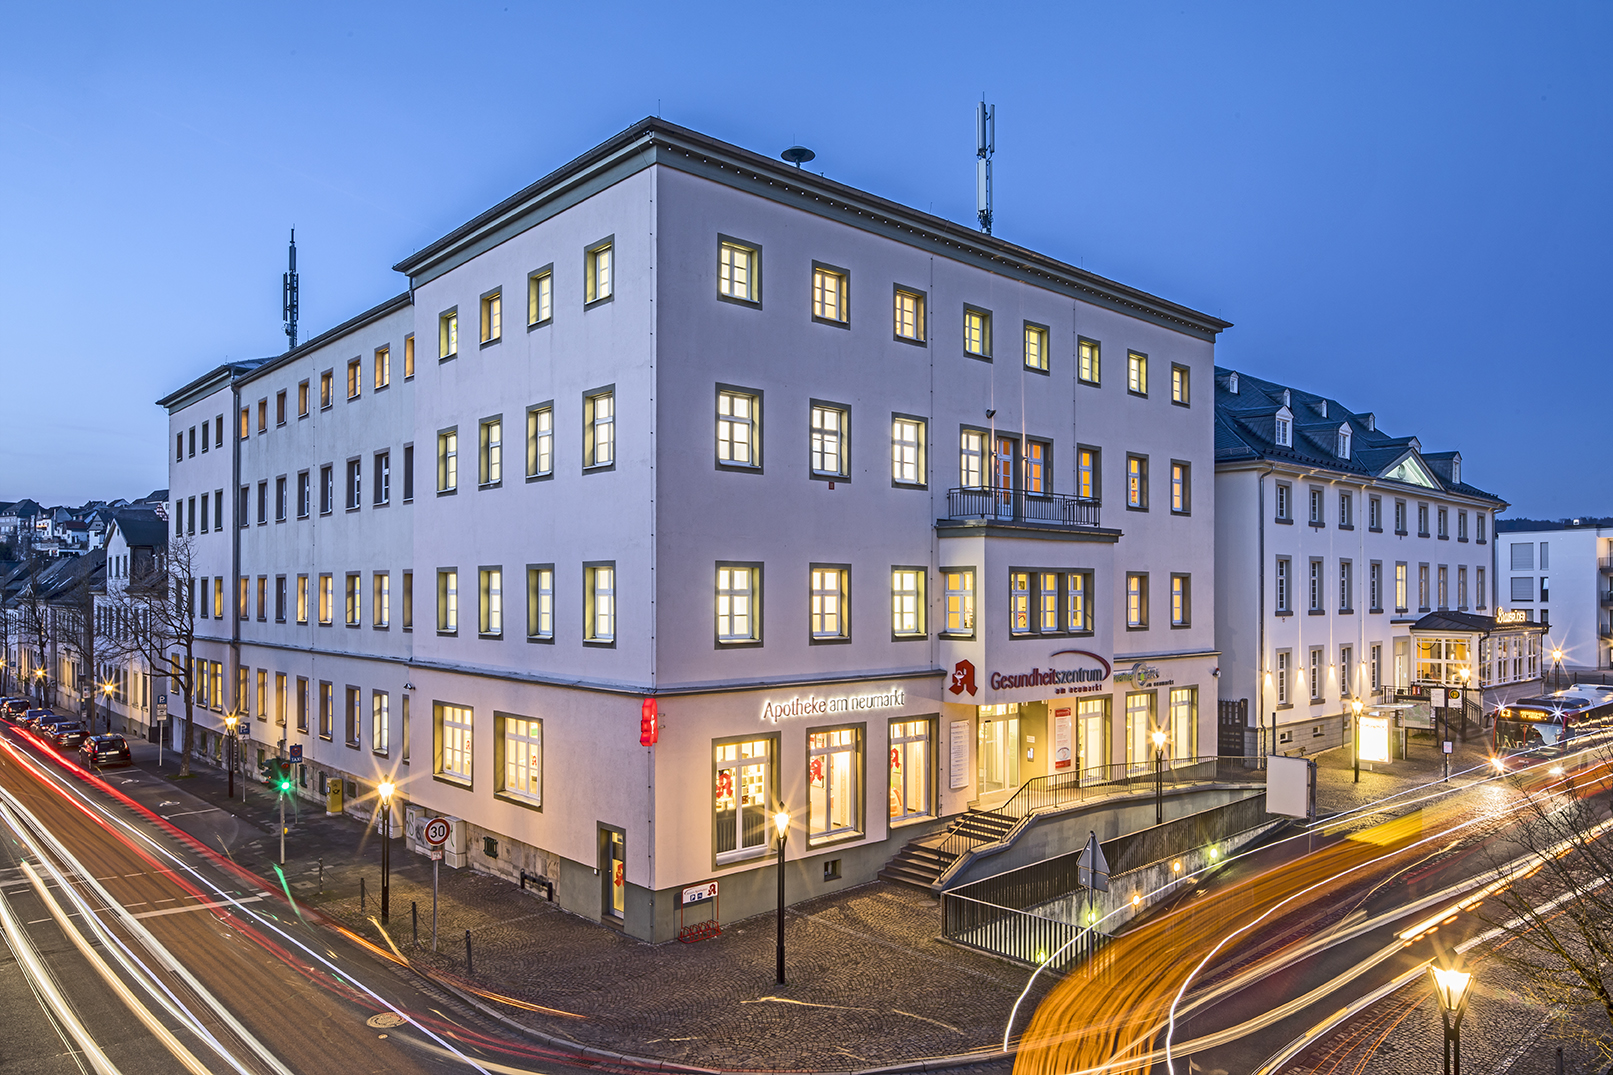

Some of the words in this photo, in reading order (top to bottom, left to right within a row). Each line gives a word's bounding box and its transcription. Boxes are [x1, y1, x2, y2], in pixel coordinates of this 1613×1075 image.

[990, 667, 1103, 691] Gesundheitszentrum
[1068, 683, 1102, 693] neumarkt
[762, 696, 827, 723] Apotheke
[829, 698, 848, 712] am
[851, 689, 905, 710] neumarkt
[240, 723, 248, 733] P
[430, 825, 445, 838] 30
